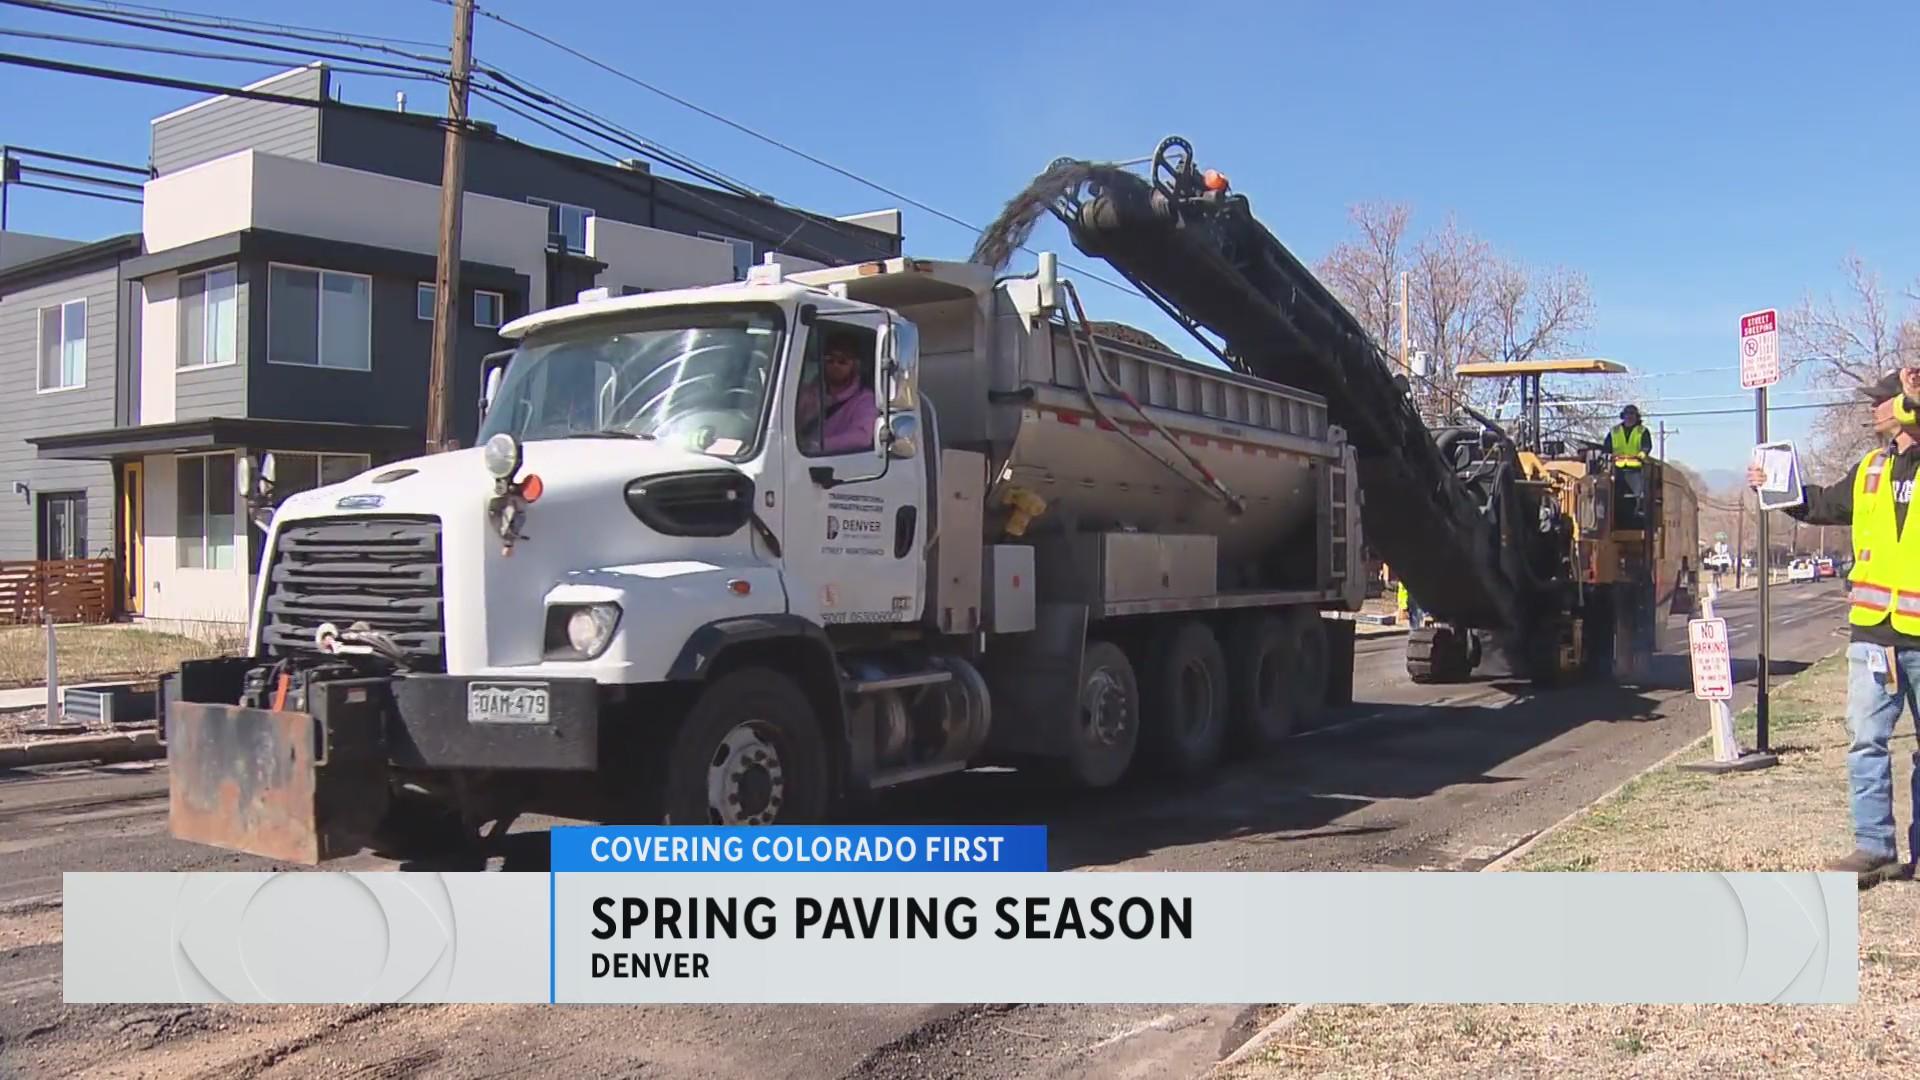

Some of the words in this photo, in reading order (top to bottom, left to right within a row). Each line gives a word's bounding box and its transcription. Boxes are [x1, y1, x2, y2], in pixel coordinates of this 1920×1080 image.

[1747, 314, 1769, 328] STREET
[1744, 321, 1774, 336] SWEEPING
[842, 519, 881, 532] DENVER
[1701, 624, 1714, 639] NO
[1692, 641, 1726, 654] PARKING
